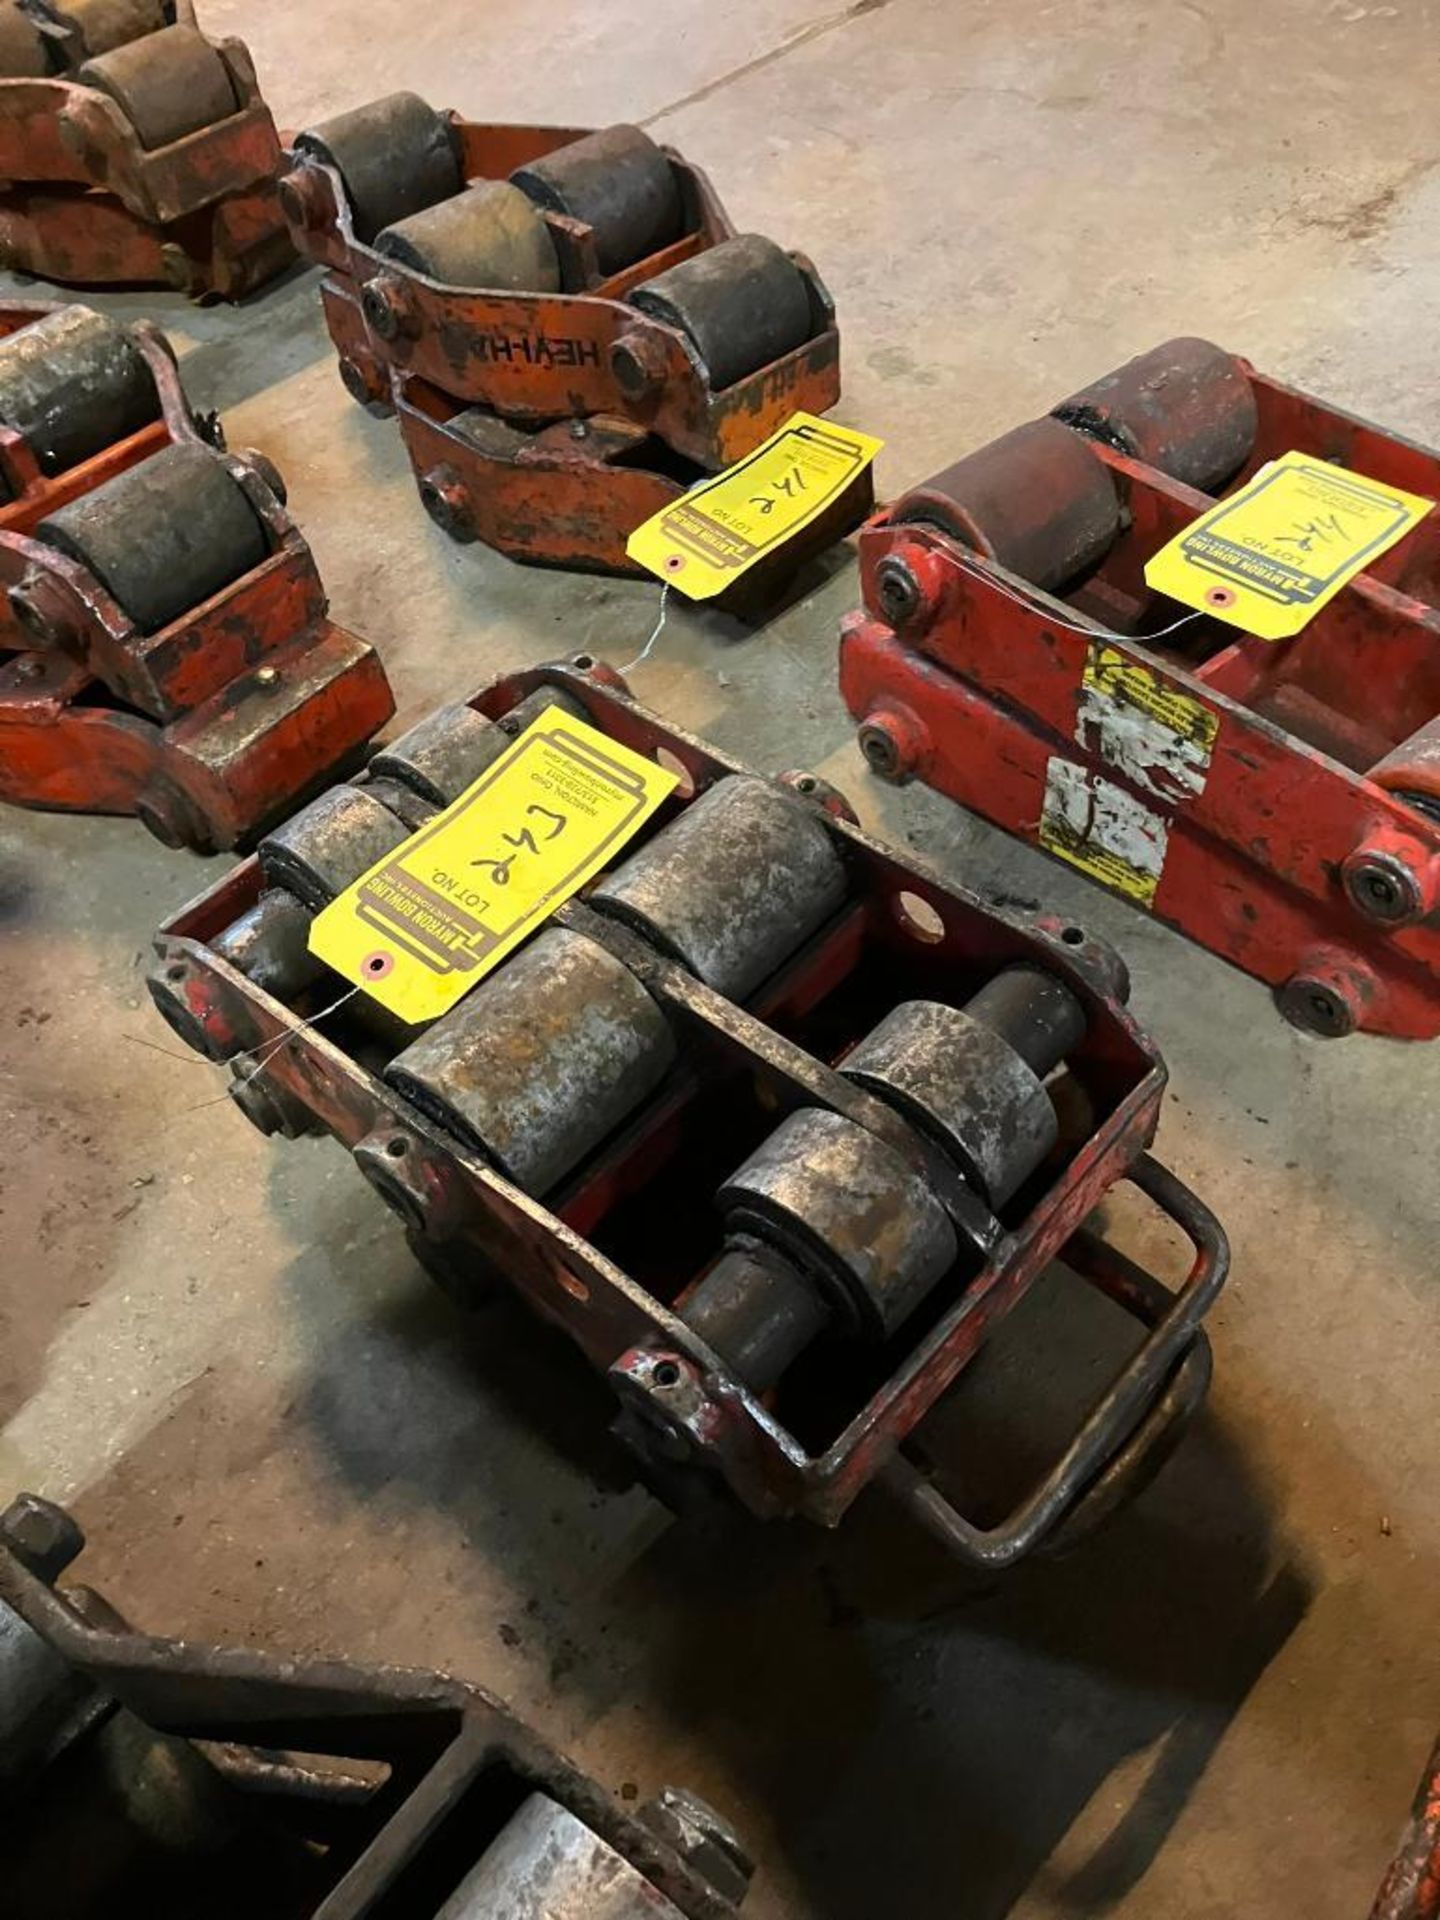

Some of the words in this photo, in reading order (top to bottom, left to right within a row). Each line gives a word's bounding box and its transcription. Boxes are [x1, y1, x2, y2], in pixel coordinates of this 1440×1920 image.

[1185, 537, 1241, 565] BOWLING
[1272, 547, 1304, 566] LOT
[1240, 559, 1285, 586] MYRON
[431, 868, 460, 892] NO.
[366, 878, 418, 917] BOWLING
[455, 888, 490, 914] LOT
[411, 910, 456, 945] MYRON
